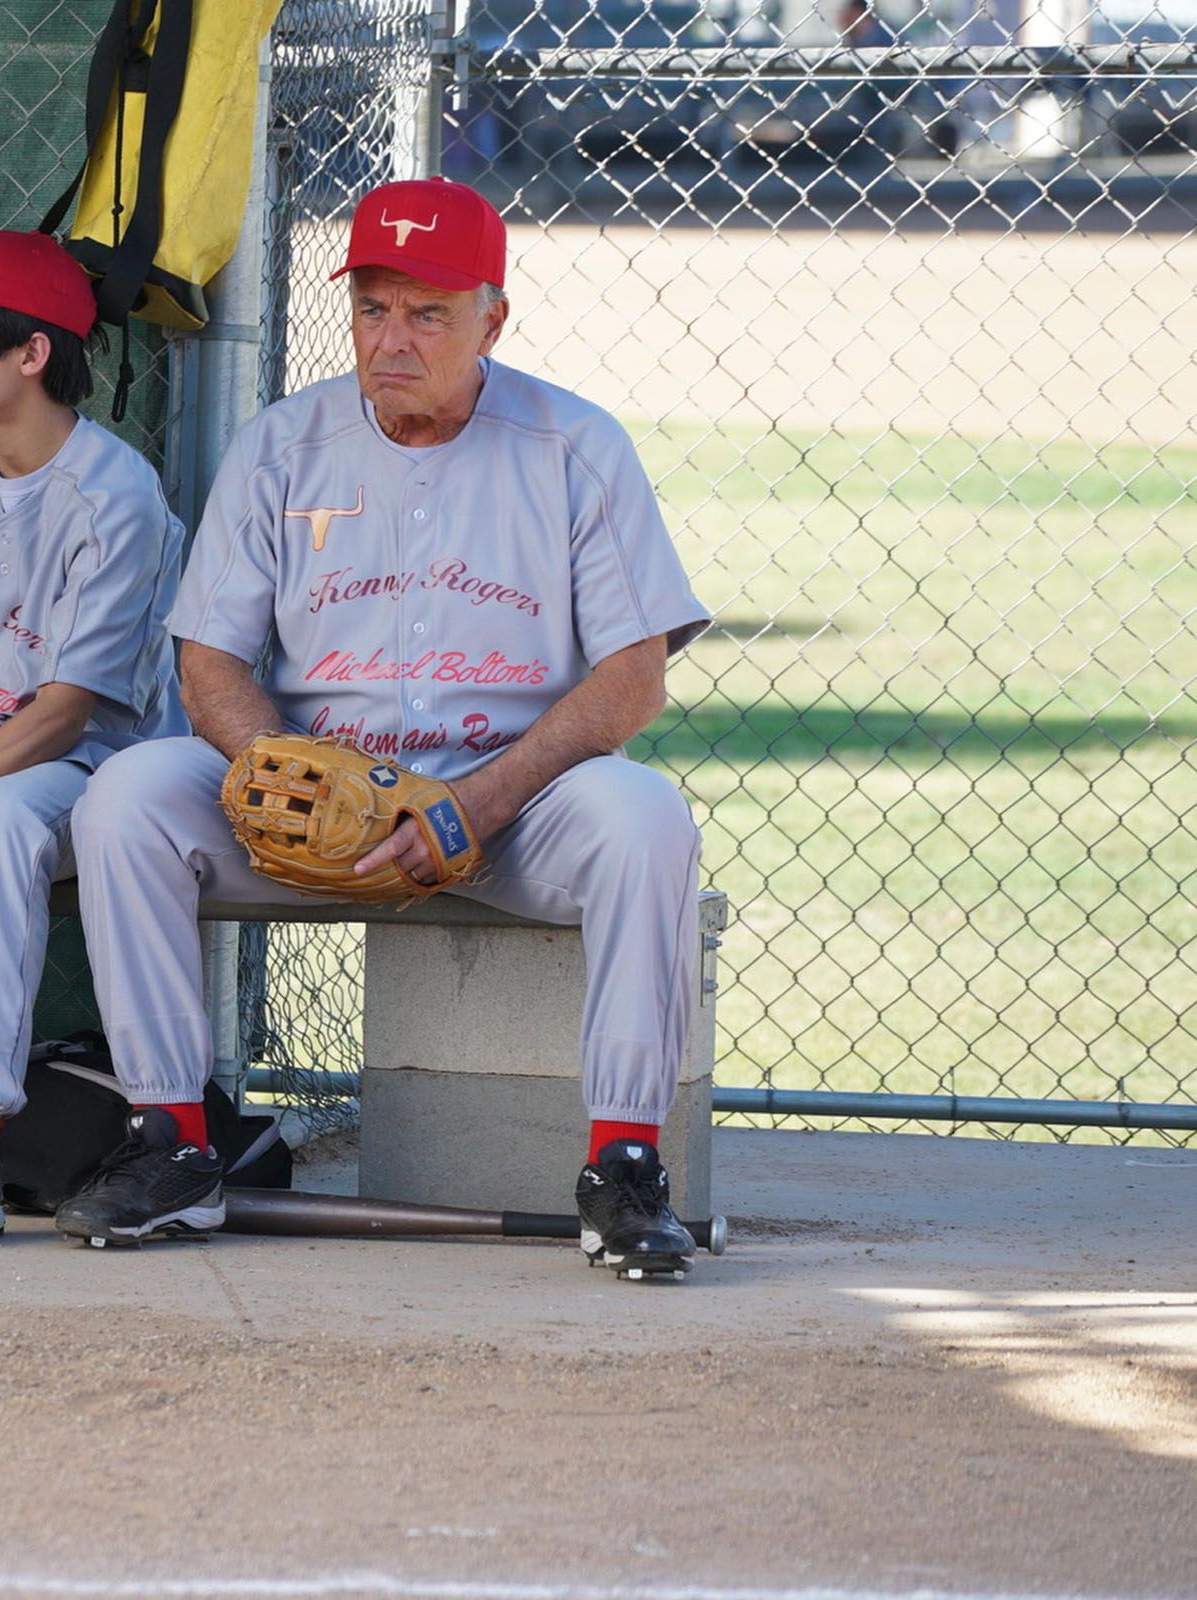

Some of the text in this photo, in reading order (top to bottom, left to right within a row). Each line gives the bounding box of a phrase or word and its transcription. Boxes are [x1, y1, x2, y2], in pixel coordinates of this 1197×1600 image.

[309, 557, 544, 618] Kenny Rogers
[305, 648, 550, 685] Michael Bolton's
